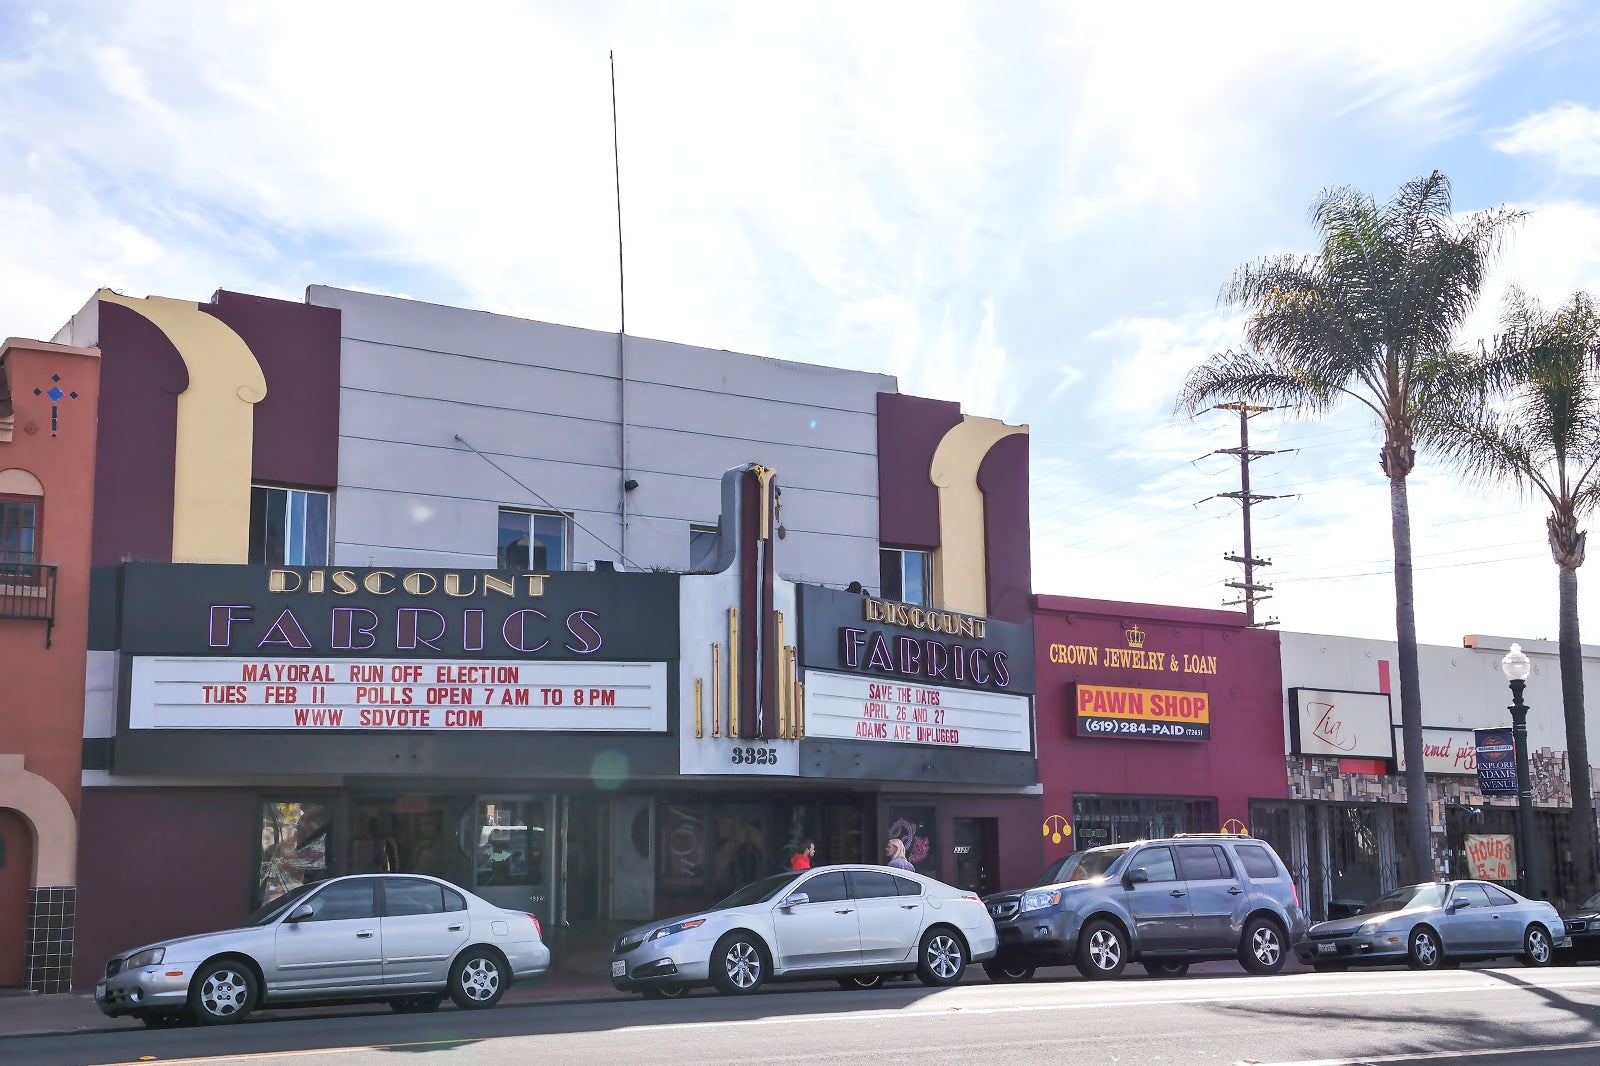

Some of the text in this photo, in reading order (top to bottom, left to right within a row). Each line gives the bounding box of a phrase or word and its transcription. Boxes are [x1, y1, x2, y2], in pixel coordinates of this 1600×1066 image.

[268, 569, 550, 598] DISCOUNT
[207, 605, 604, 654] FABRICS
[864, 598, 985, 639] DISCOUNT
[843, 628, 1010, 687] FABRICS
[1049, 643, 1217, 675] CROWN JEWELRY & LOAN
[242, 664, 519, 684] MAYORAL RUN OFF ELECTION
[203, 685, 247, 704] TUES
[265, 686, 297, 704] FEB
[356, 687, 413, 705] POLLS
[427, 687, 473, 706] OPEN
[484, 687, 495, 706] 7
[501, 687, 530, 706] AM
[541, 688, 563, 706] TO
[574, 688, 584, 706] 8
[590, 688, 615, 707] PM
[869, 684, 940, 706] SAVE THE DATES
[1080, 689, 1206, 719] PAWN SHOP
[295, 708, 483, 728] WWW SDVOTE COM
[863, 704, 945, 725] APRIL 26 AND 27
[856, 721, 960, 744] ADAMS AVE UNPLUGGED
[1086, 719, 1118, 733] (619)
[1120, 722, 1184, 735] 284-PAID
[1306, 701, 1357, 751] Zia
[731, 747, 777, 765] 3325
[1477, 761, 1515, 770] EXPLORE
[1479, 770, 1516, 779] ADAMS
[1481, 780, 1517, 788] AVENUE
[1468, 837, 1512, 863] HOURS
